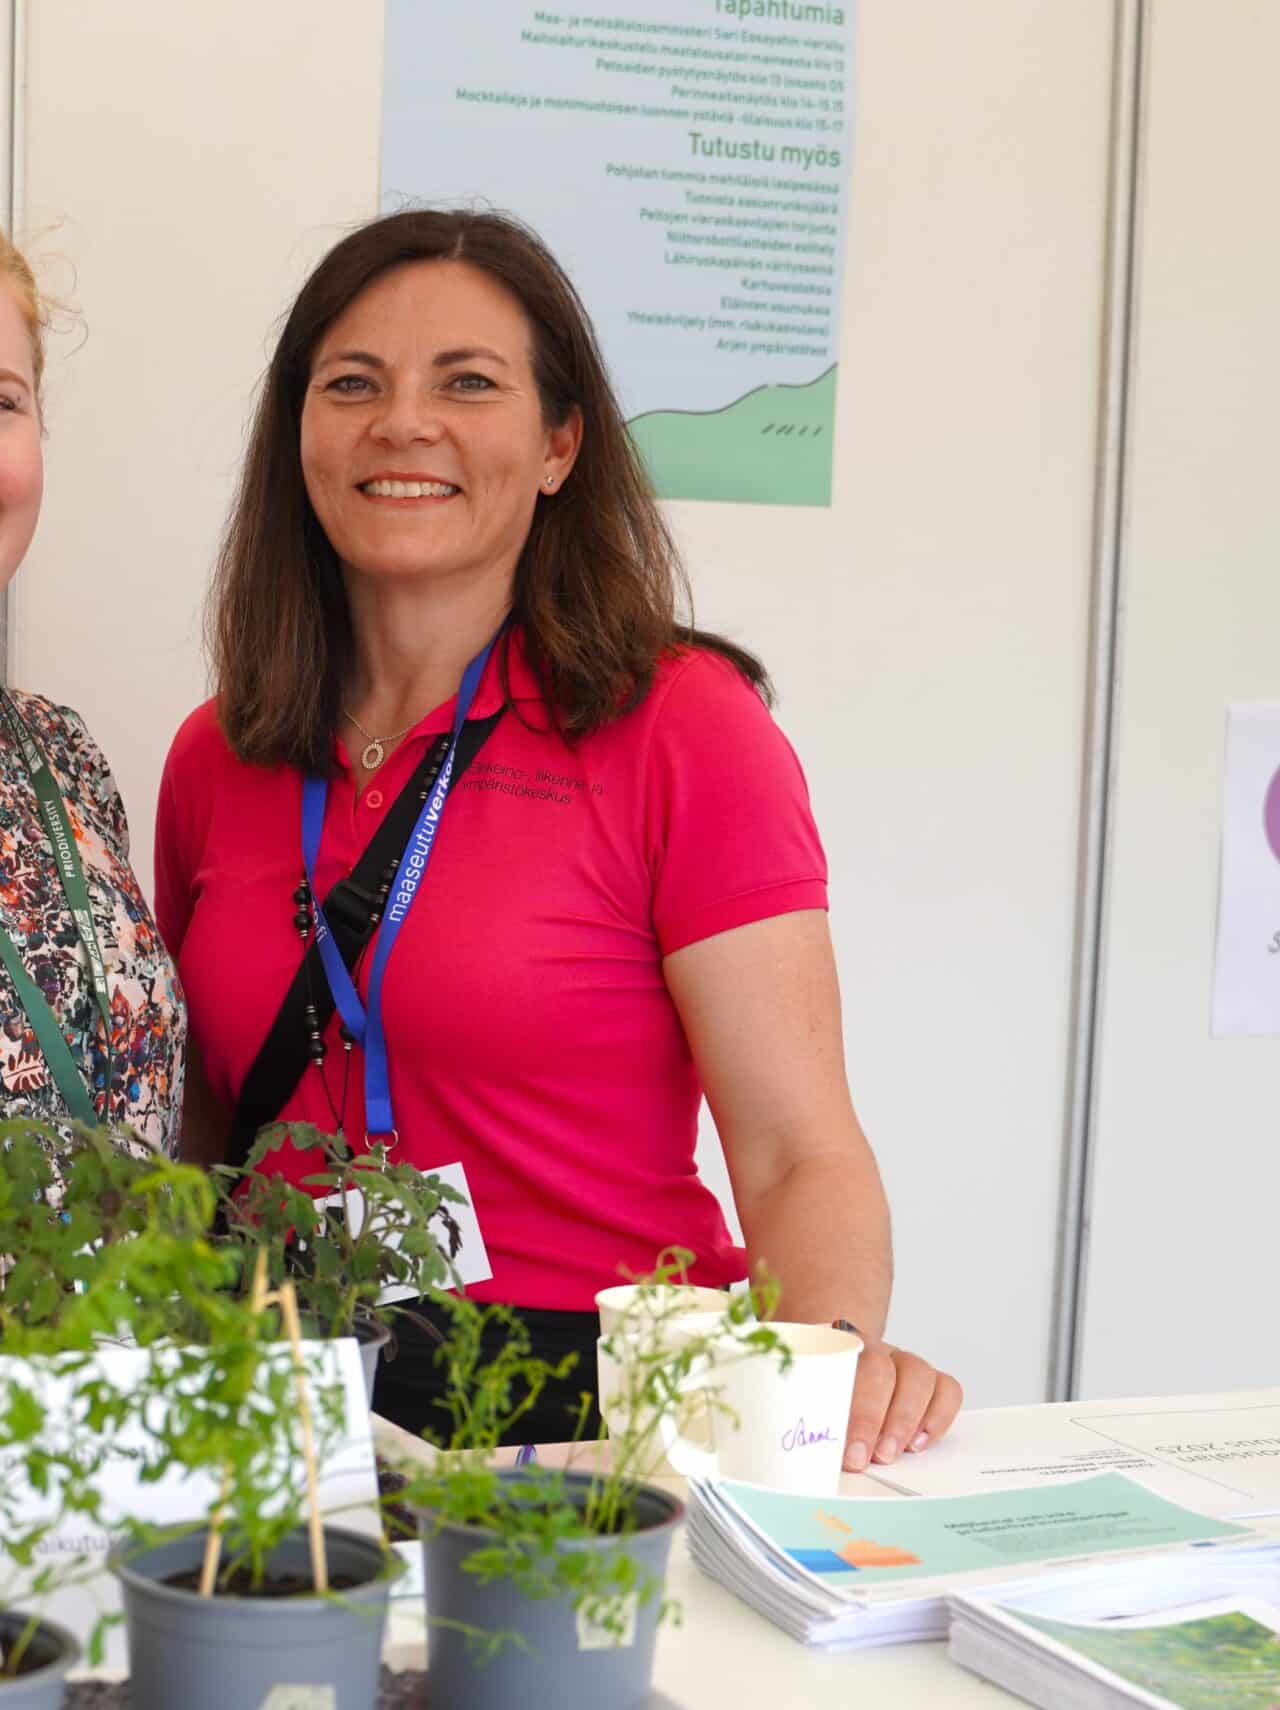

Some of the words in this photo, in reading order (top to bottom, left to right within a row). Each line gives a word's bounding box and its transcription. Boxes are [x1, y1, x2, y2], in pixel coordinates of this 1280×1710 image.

[687, 132, 775, 162] Tutustu
[780, 143, 841, 171] myös
[43, 799, 76, 878] PRIODIVERSITY
